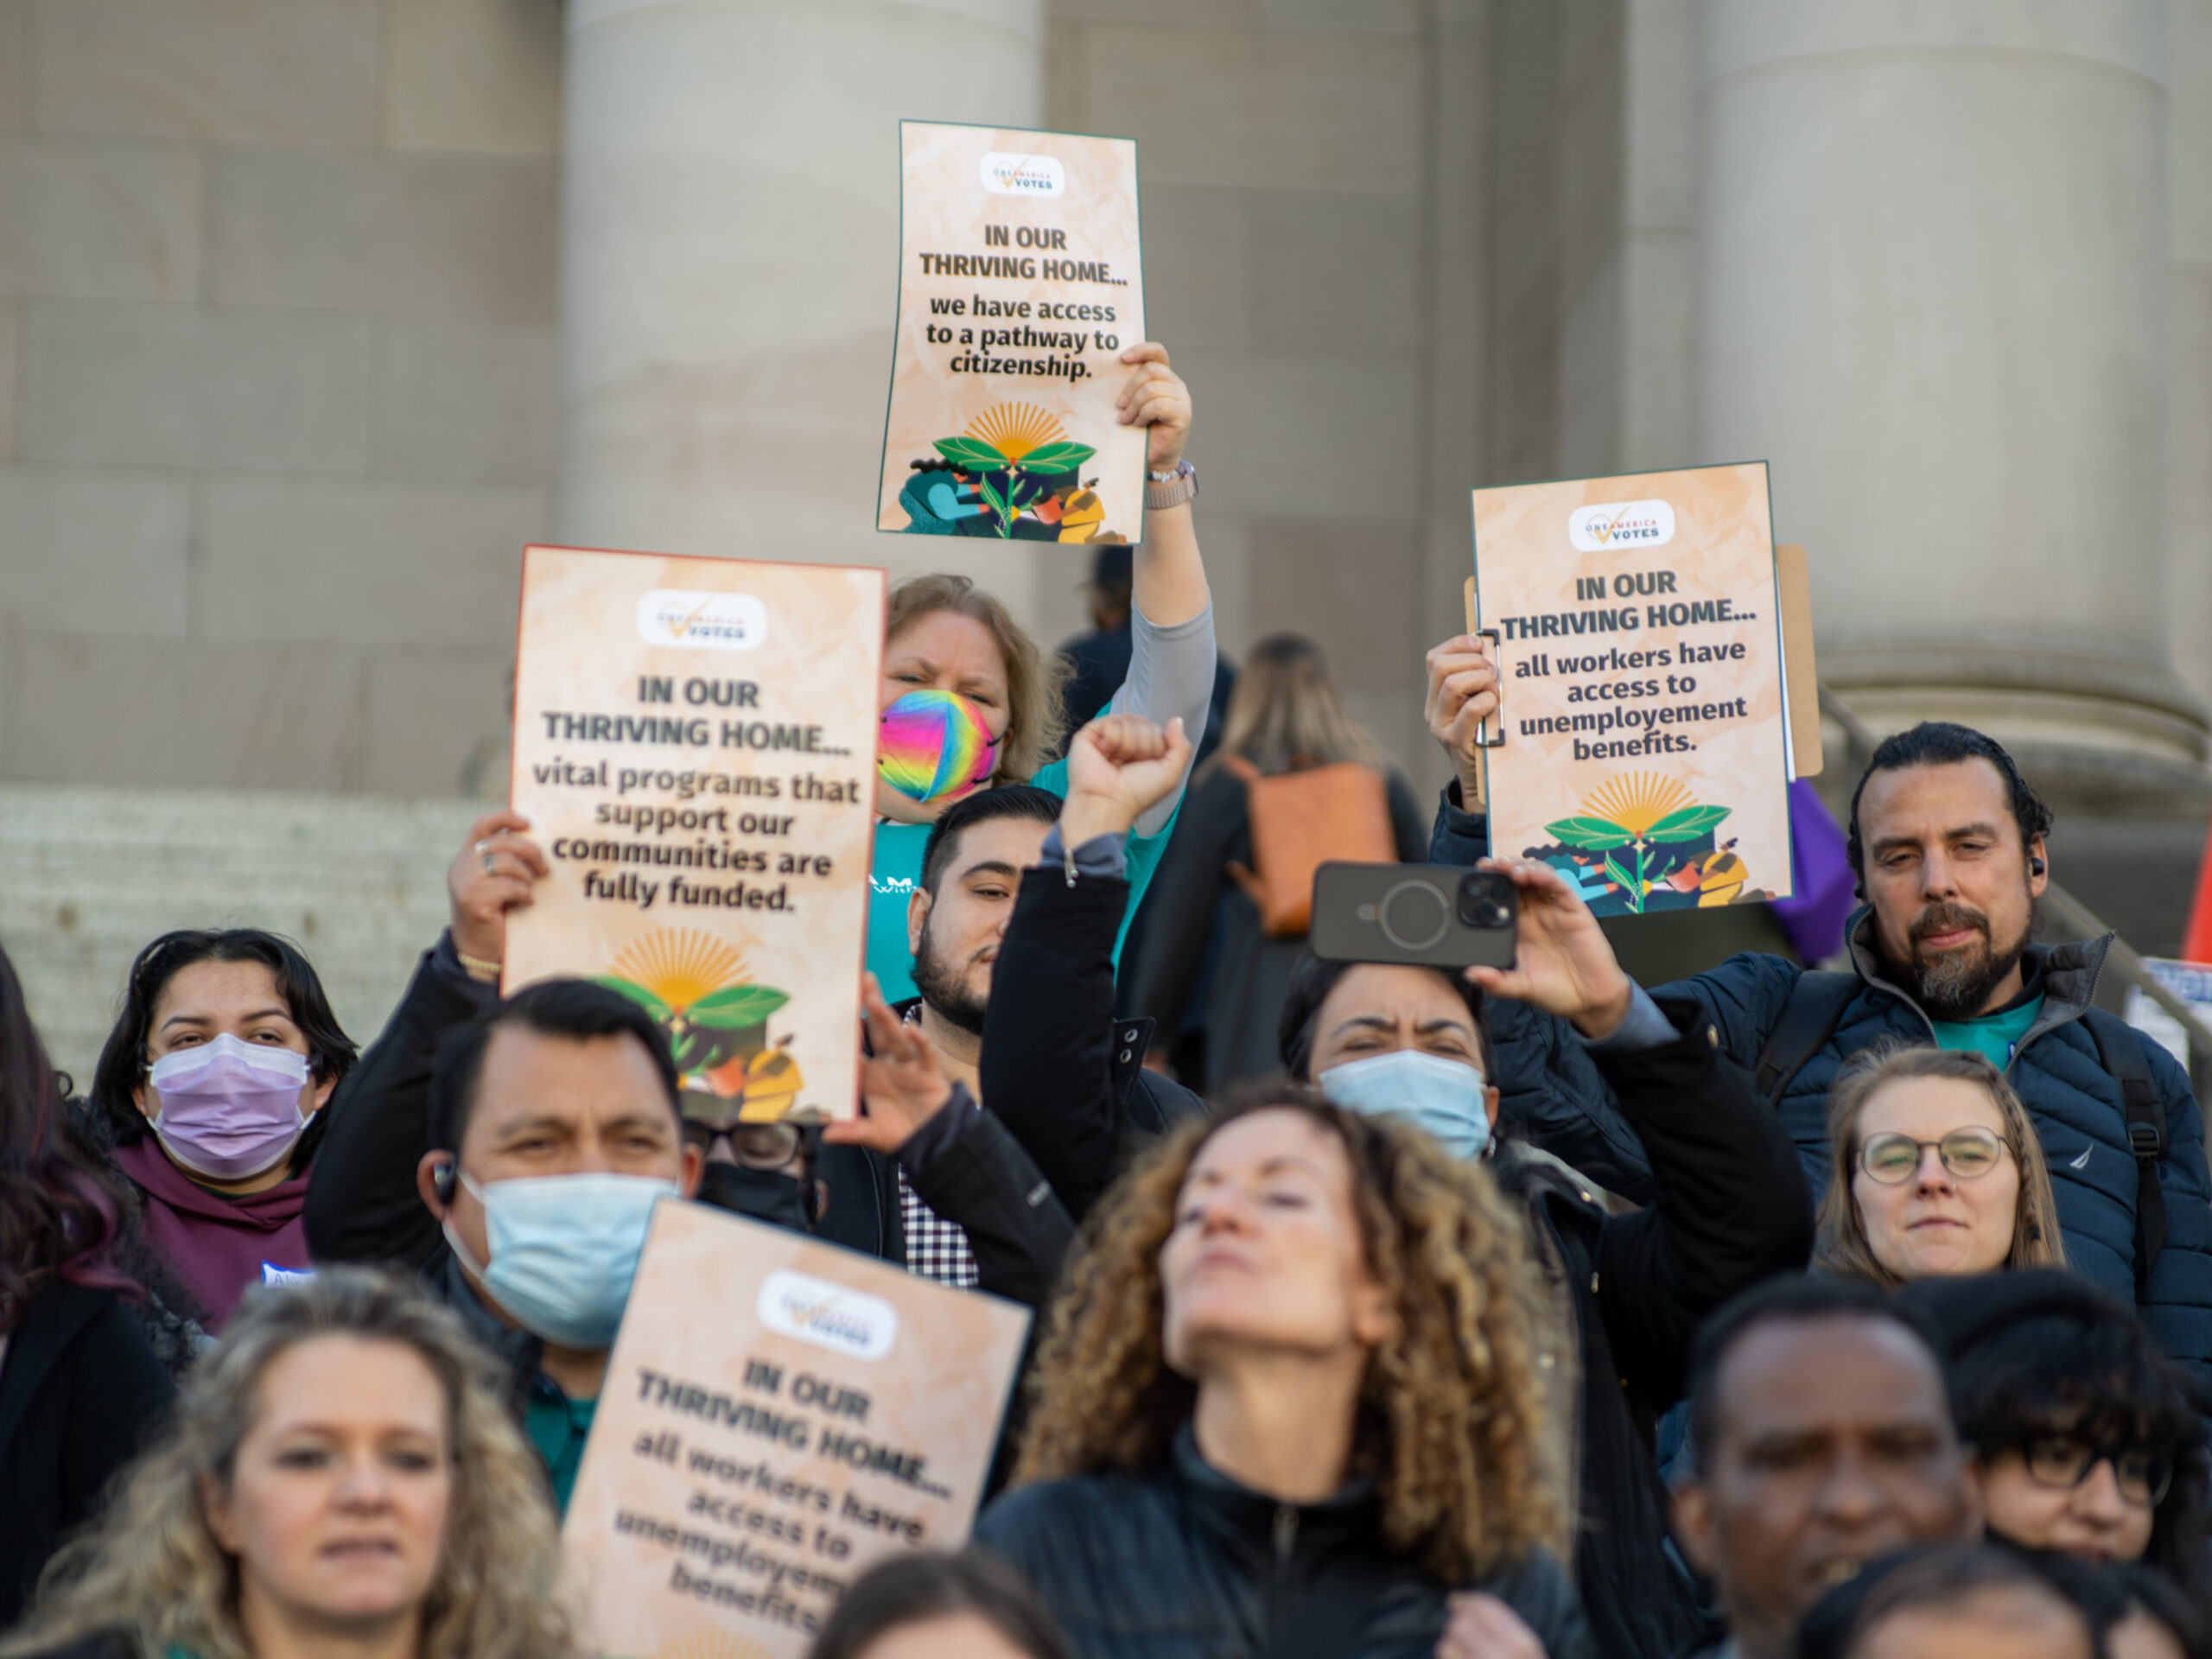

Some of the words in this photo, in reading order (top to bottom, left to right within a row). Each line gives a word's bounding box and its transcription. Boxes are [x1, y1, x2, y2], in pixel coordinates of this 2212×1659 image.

[1015, 178, 1053, 189] VOTES
[985, 225, 1009, 247] IN
[1015, 226, 1067, 250] OUR
[919, 252, 1036, 279] THRIVING
[1042, 258, 1128, 286] HOME...
[930, 297, 966, 315] we
[972, 294, 1032, 318] have
[1038, 302, 1116, 322] access
[926, 323, 953, 344] to
[959, 328, 973, 345] a
[980, 325, 1088, 354] pathway
[1094, 329, 1120, 350] to
[950, 349, 1092, 383] citizenship.
[1612, 528, 1659, 540] VOTES
[1576, 575, 1606, 601] IN
[1614, 570, 1678, 598] OUR
[1500, 607, 1640, 640] THRIVING
[1647, 598, 1758, 629] HOME...
[1515, 653, 1550, 678] all
[1556, 645, 1673, 674] workers
[1679, 641, 1747, 664] have
[637, 676, 674, 702] IN
[683, 678, 760, 708] OUR
[1567, 678, 1660, 702] access
[1666, 674, 1697, 695] to
[1520, 696, 1748, 735] unemployement
[541, 712, 709, 747] THRIVING
[720, 721, 851, 757] HOME...
[1573, 730, 1697, 760] benefits.
[532, 756, 608, 786] vital
[616, 767, 781, 798] programs
[791, 772, 861, 804] that
[595, 802, 729, 835] support
[738, 812, 796, 836] our
[551, 836, 768, 874] communities
[777, 853, 833, 877] are
[582, 870, 658, 908] fully
[668, 875, 796, 912] funded.
[744, 1356, 785, 1395] IN
[790, 1372, 873, 1423] OUR
[637, 1367, 809, 1452] THRIVING
[817, 1427, 954, 1501] HOME...
[633, 1430, 680, 1465] all
[688, 1445, 833, 1512] workers
[841, 1488, 925, 1543] have
[688, 1488, 804, 1543] access
[814, 1525, 852, 1559] to
[614, 1508, 846, 1599] unemployem
